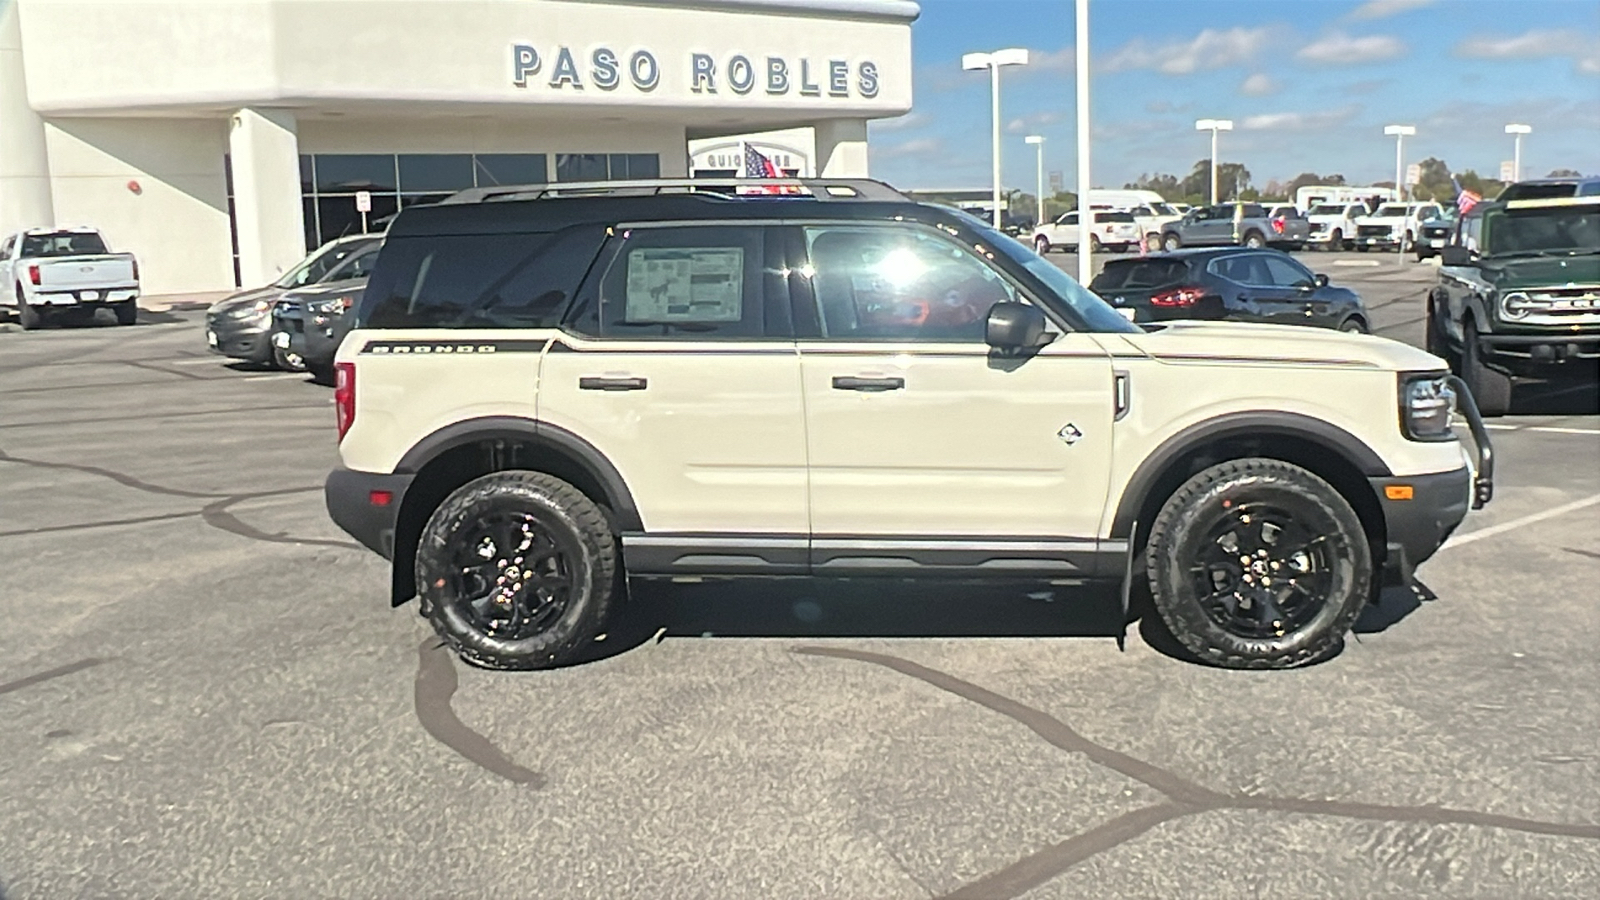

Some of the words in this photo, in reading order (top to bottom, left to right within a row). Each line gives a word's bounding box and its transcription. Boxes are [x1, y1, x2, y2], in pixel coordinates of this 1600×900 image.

[513, 45, 660, 92] PASO
[691, 53, 879, 99] ROBLES
[707, 154, 742, 168] QUIC
